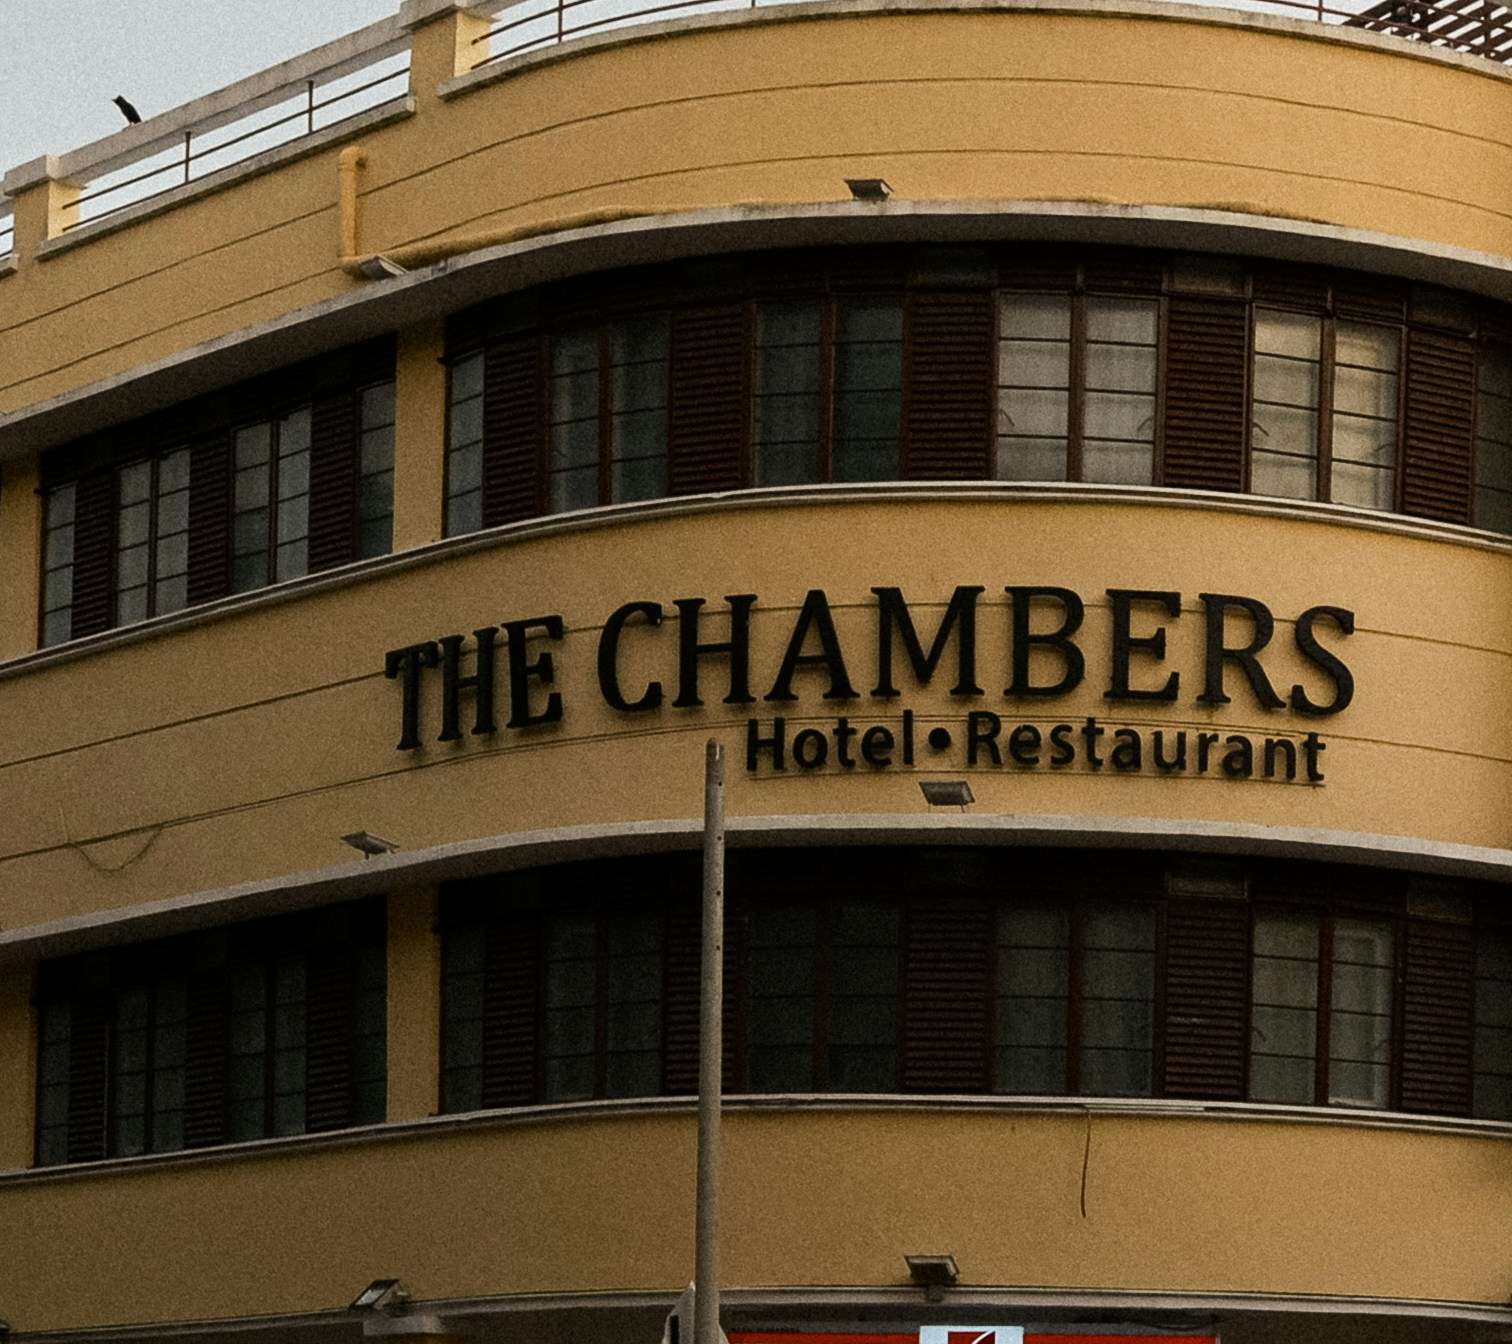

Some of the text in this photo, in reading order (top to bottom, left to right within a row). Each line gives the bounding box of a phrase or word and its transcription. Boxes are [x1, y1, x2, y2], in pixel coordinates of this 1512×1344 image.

[385, 585, 1355, 751] THE CHAMBERS
[747, 709, 1326, 782] Hotel Restaurant
